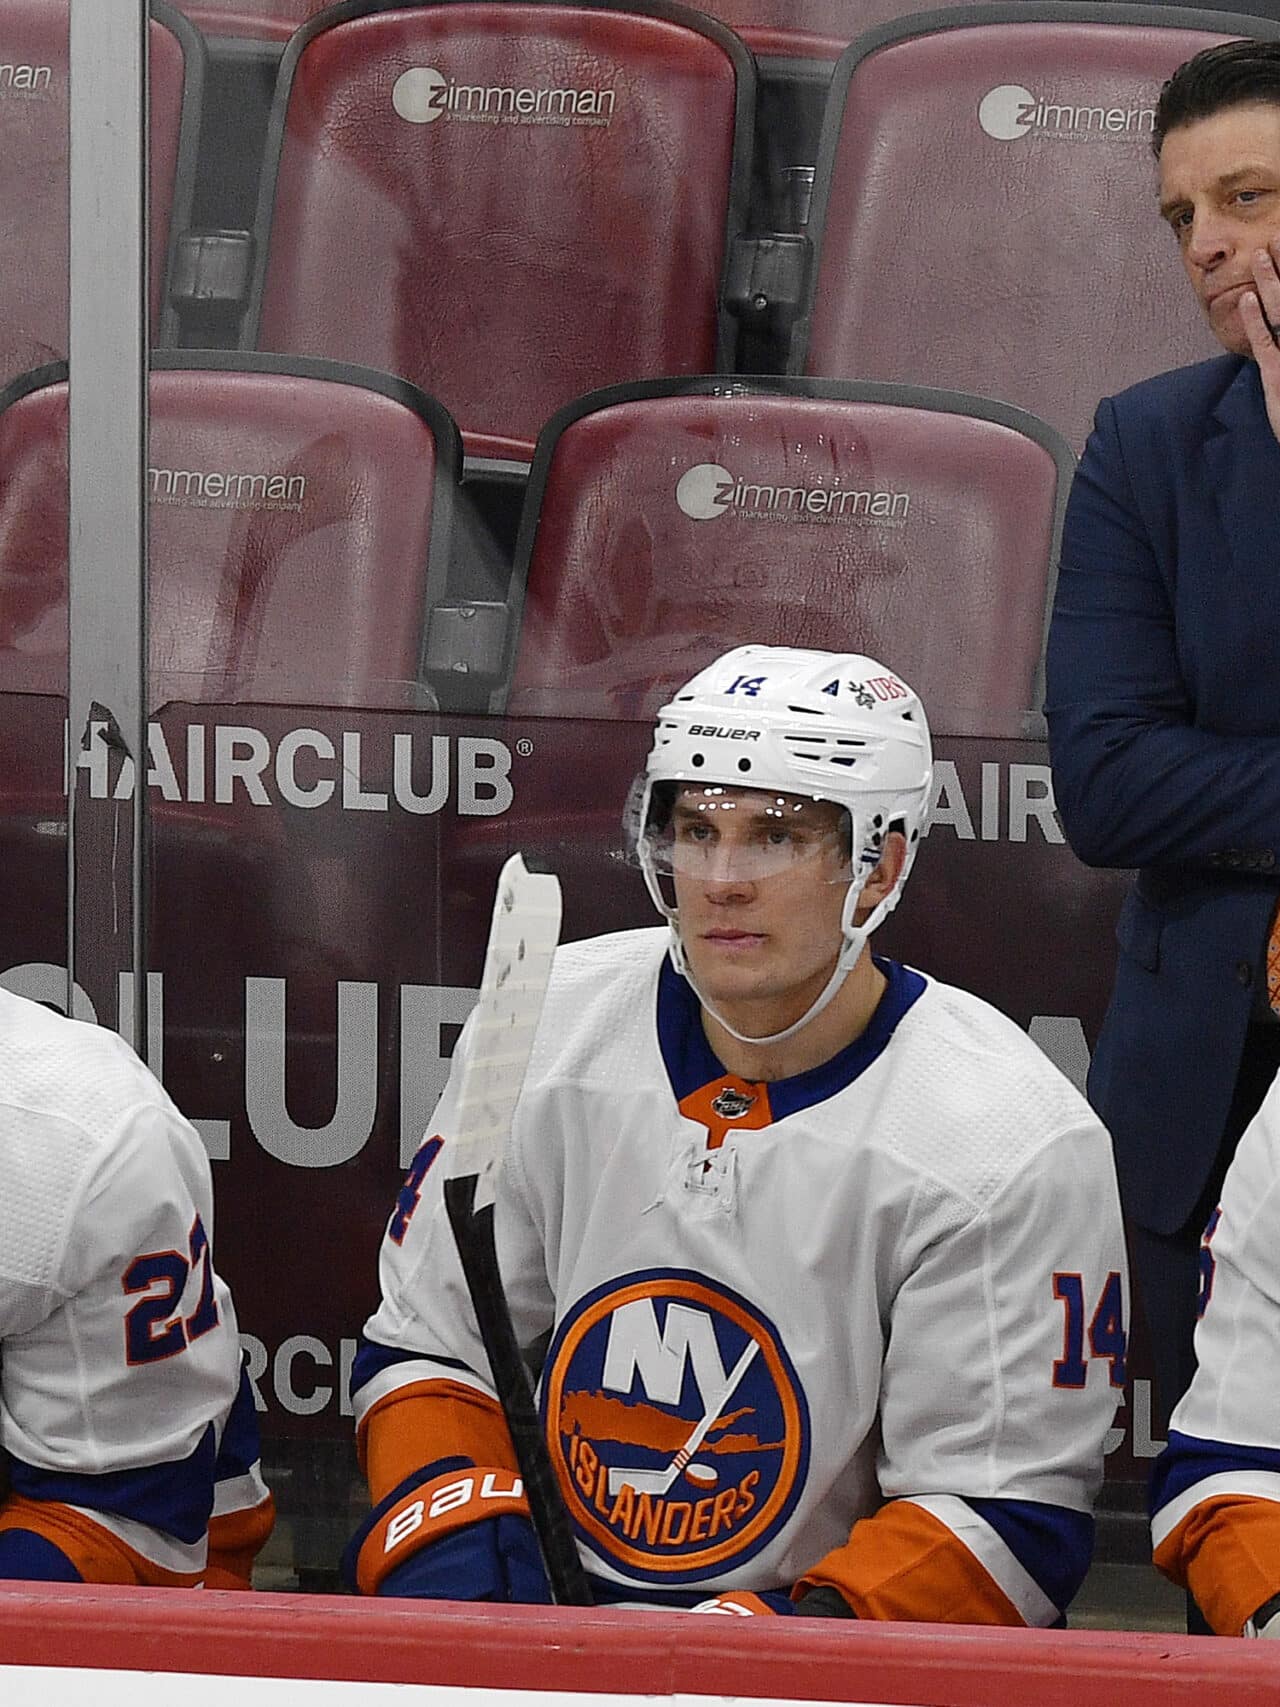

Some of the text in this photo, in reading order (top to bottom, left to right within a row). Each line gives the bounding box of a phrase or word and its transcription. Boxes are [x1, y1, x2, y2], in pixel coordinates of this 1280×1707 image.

[429, 77, 616, 115] zimmerman
[712, 476, 911, 519] zimmerman
[724, 675, 769, 697] 14
[866, 675, 908, 701] UBS
[1052, 1271, 1127, 1390] 14
[570, 1434, 761, 1547] ISLANDERS
